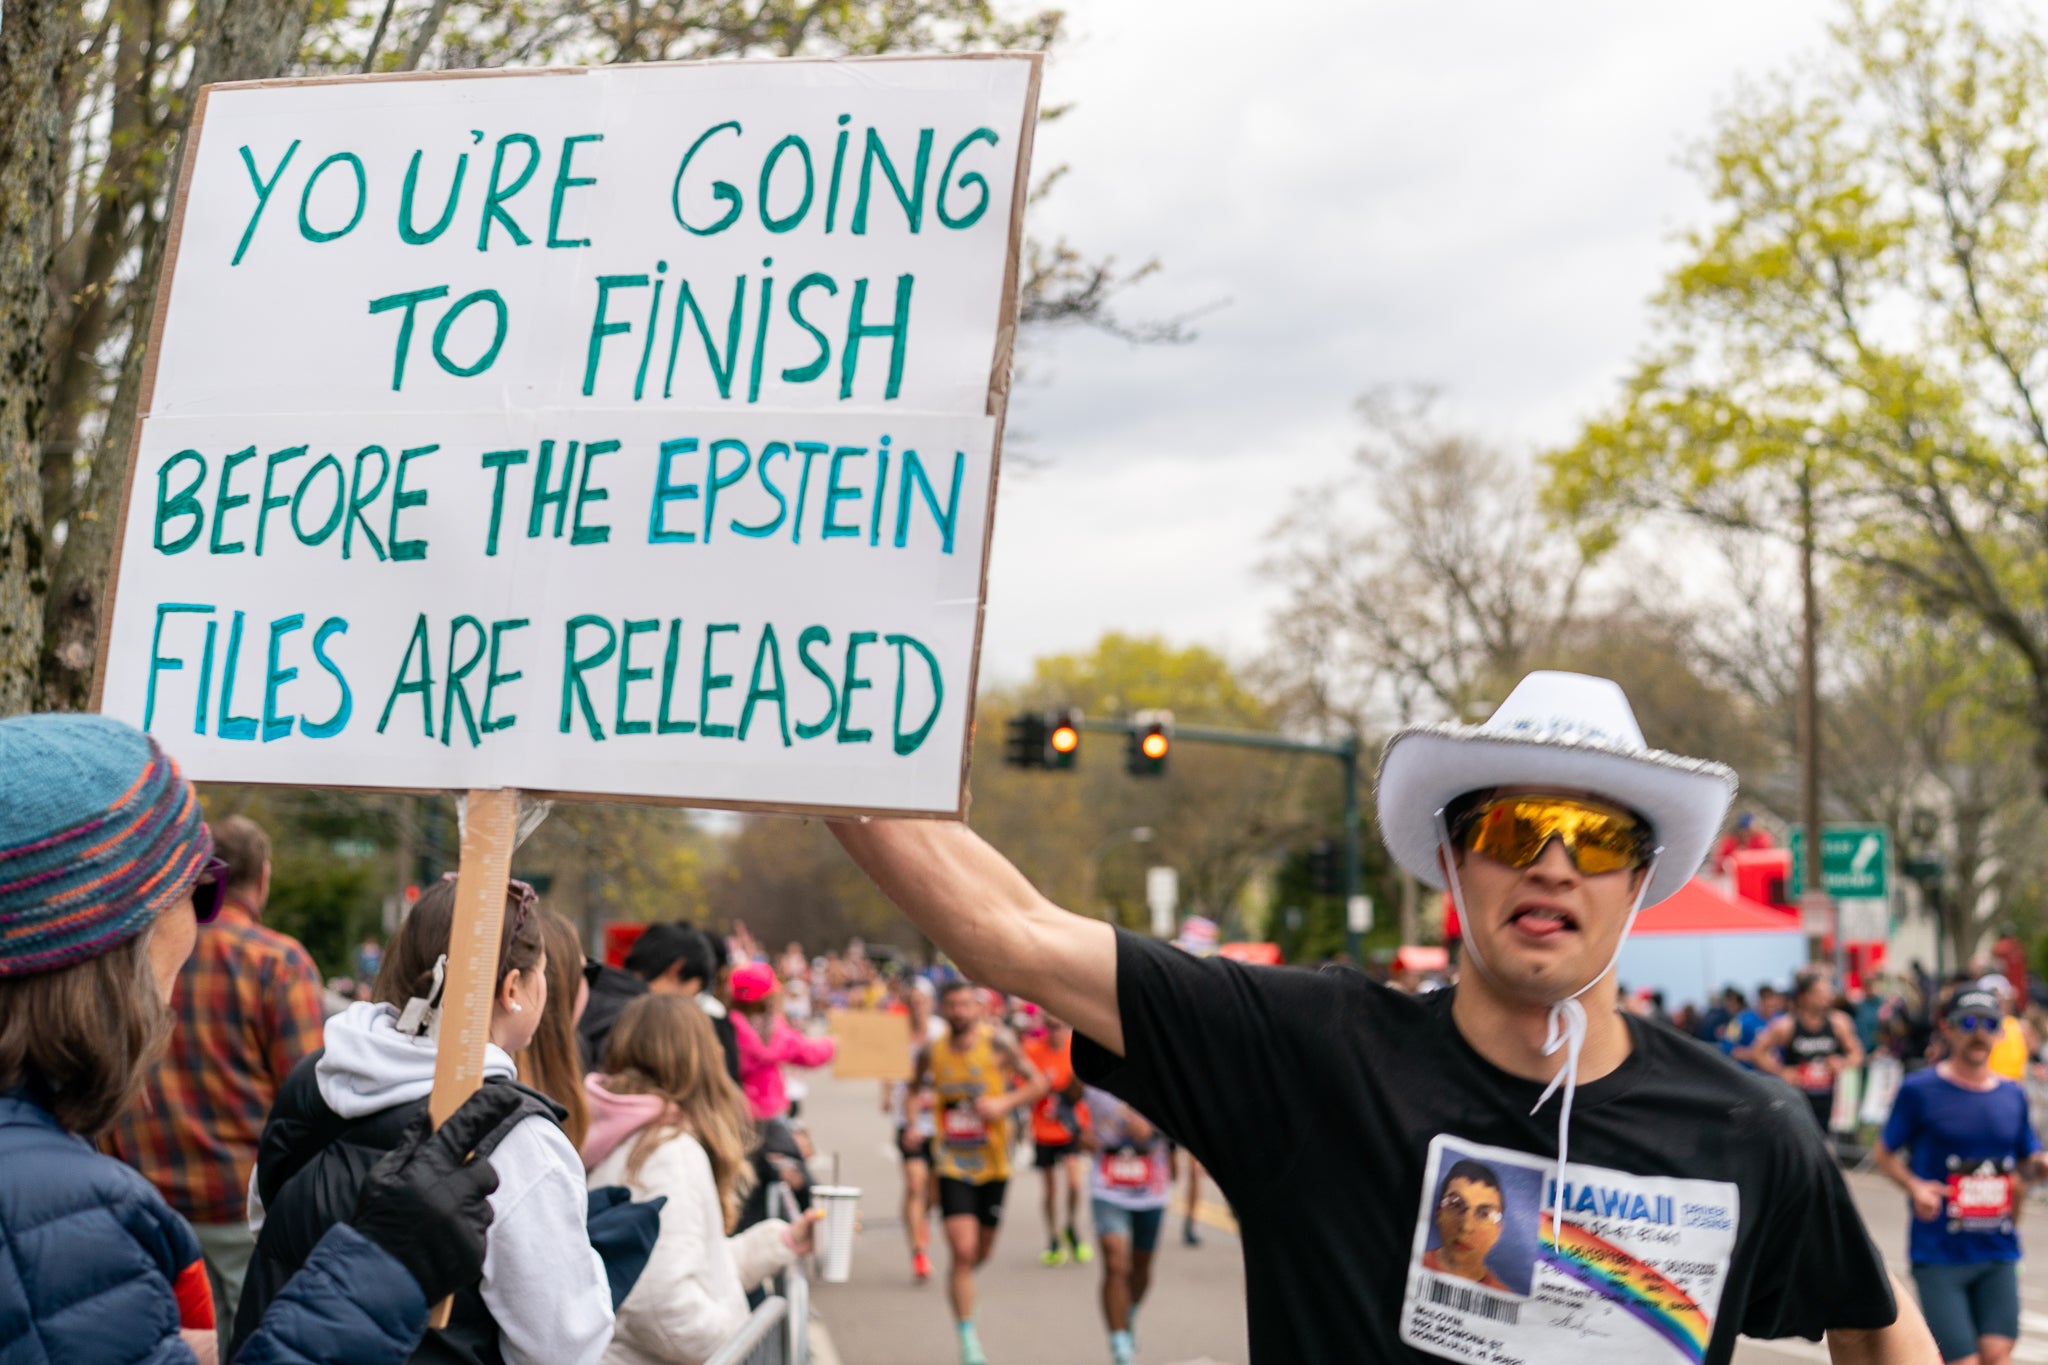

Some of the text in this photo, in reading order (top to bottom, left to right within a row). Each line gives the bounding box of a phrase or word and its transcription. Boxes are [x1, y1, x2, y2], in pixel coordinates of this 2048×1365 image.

[232, 114, 999, 266] YOU'RE GOING
[369, 257, 914, 403] TO FINISH
[153, 434, 965, 562] BEFORE THE EPSTEIN
[143, 602, 944, 756] FILES ARE RELEASED
[1547, 1179, 1674, 1226] HAWAII
